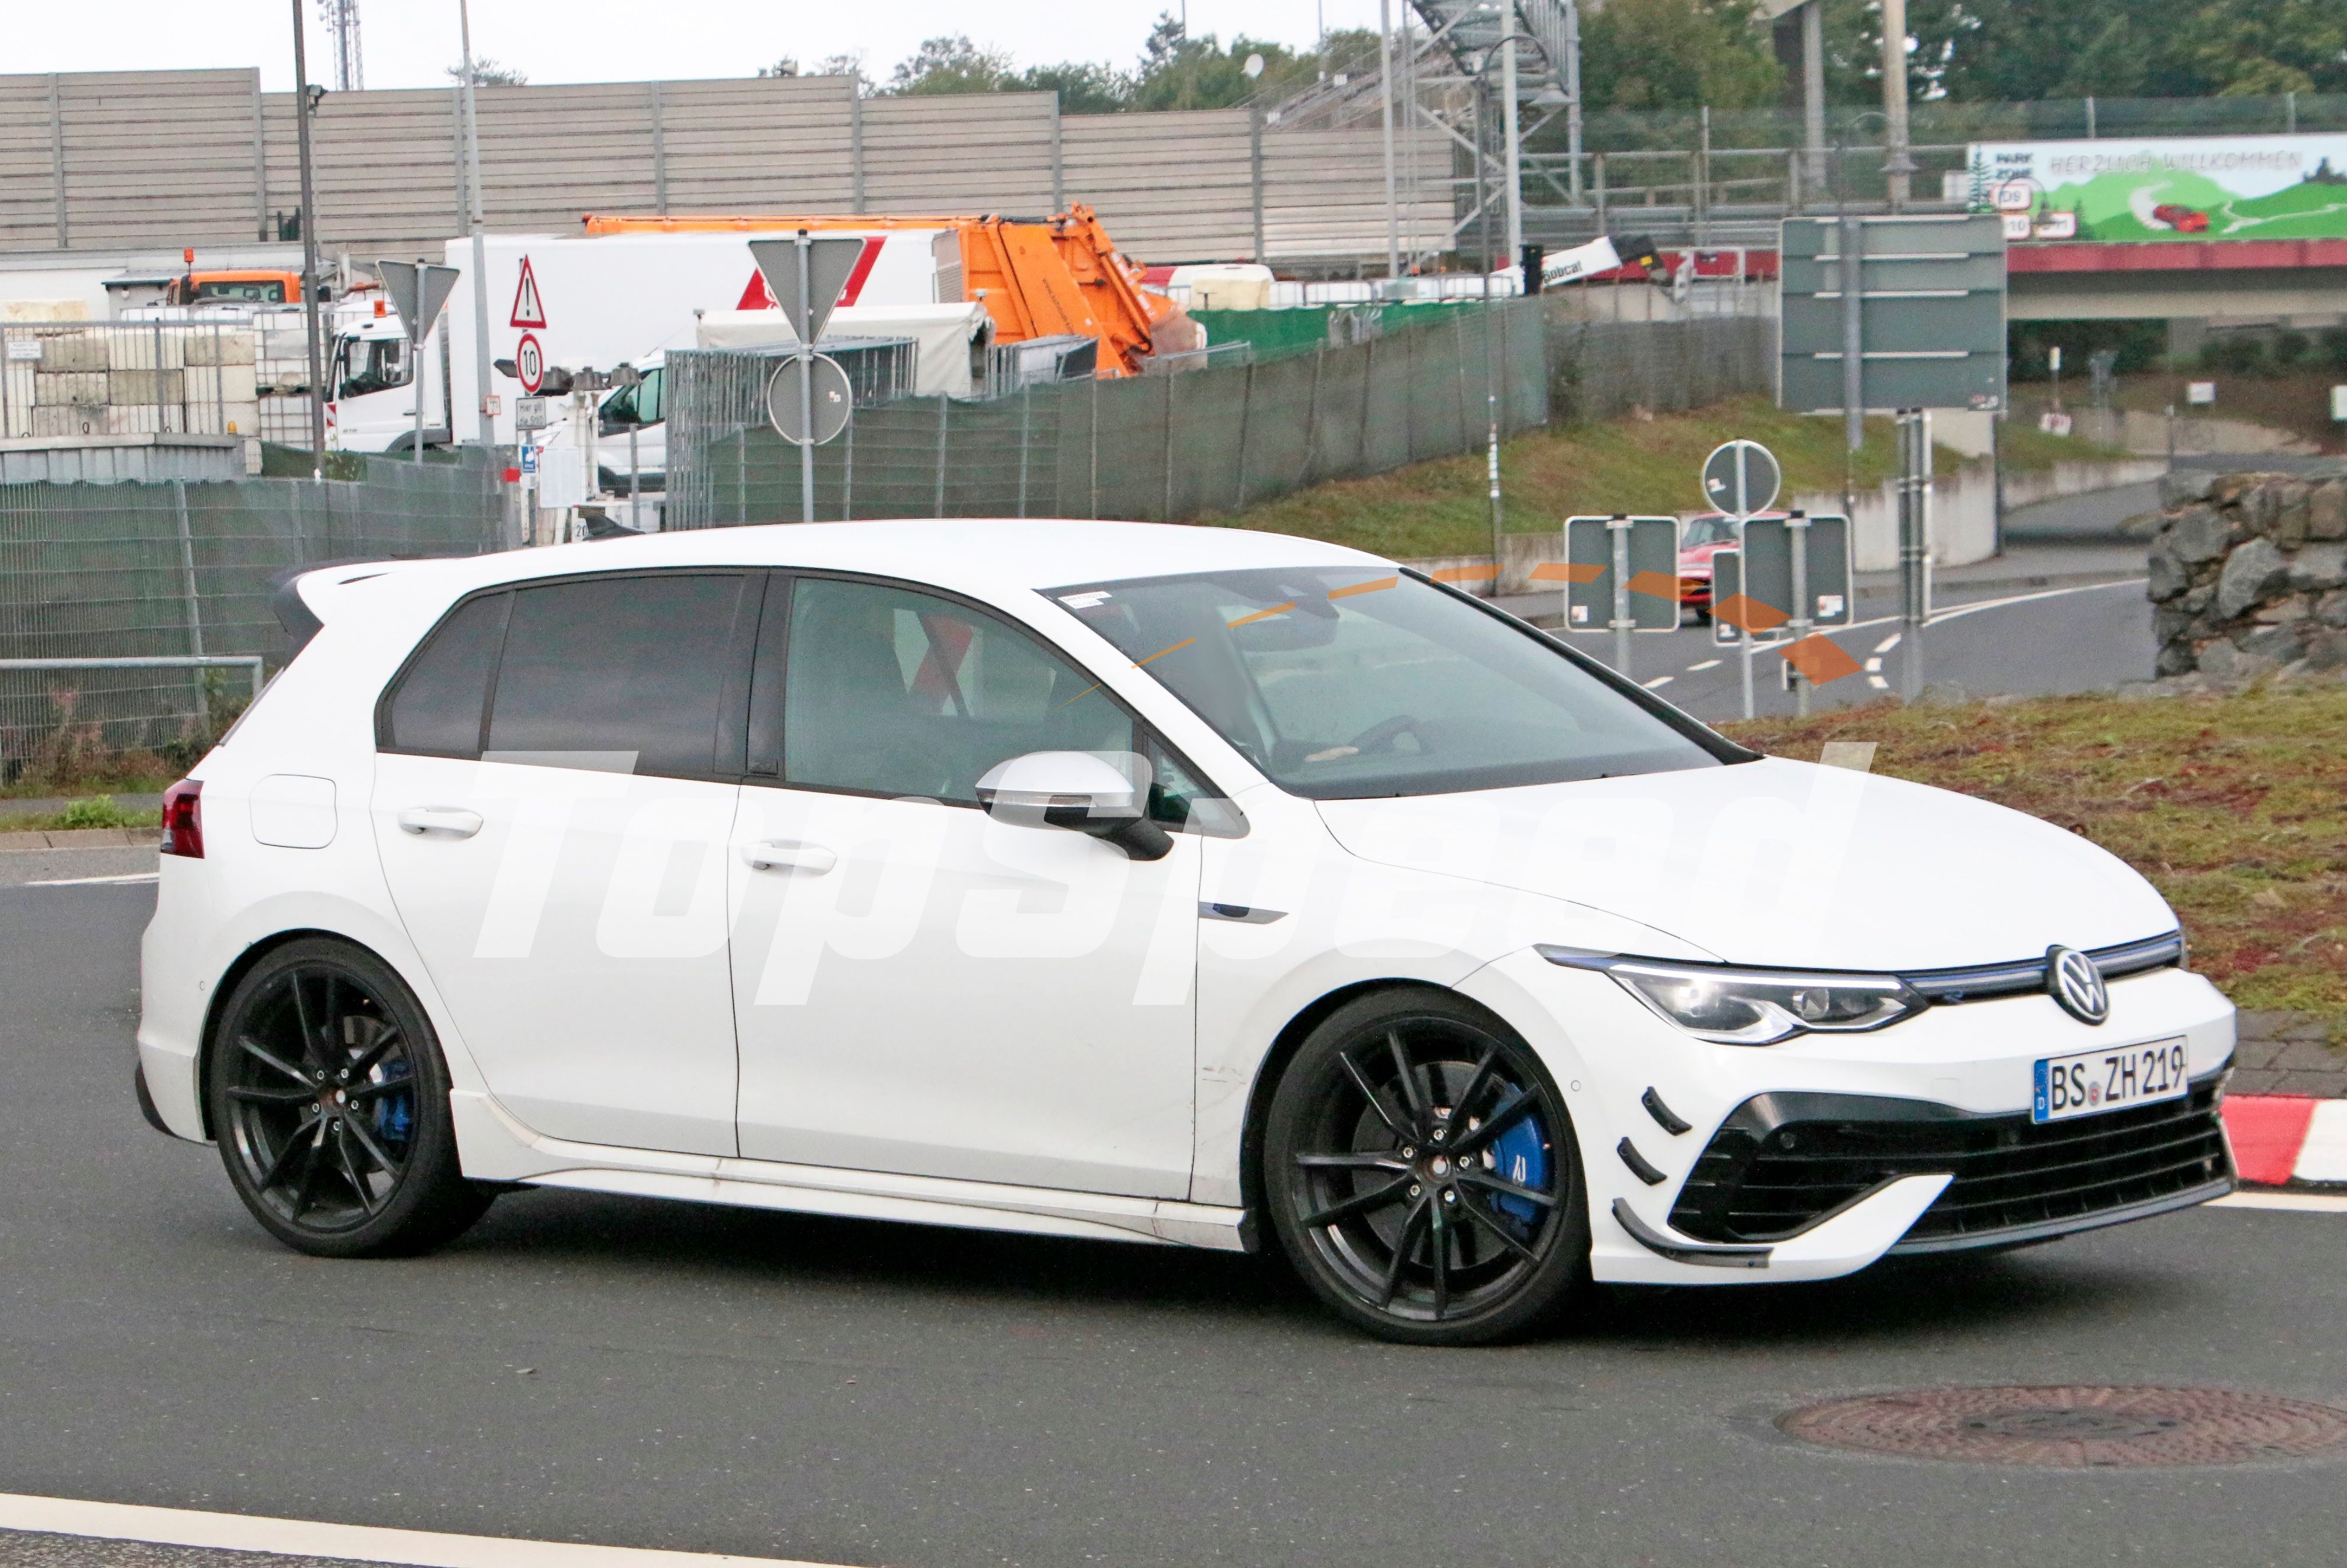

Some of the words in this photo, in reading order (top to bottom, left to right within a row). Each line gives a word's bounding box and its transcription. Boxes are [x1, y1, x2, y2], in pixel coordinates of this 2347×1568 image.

[2050, 152, 2151, 174] HERZLICH
[2163, 150, 2302, 170] WILLKOMMEN
[523, 350, 537, 376] 10
[2051, 1062, 2086, 1111] BS
[2105, 1053, 2137, 1102] ZH
[2142, 1044, 2186, 1094] 219
